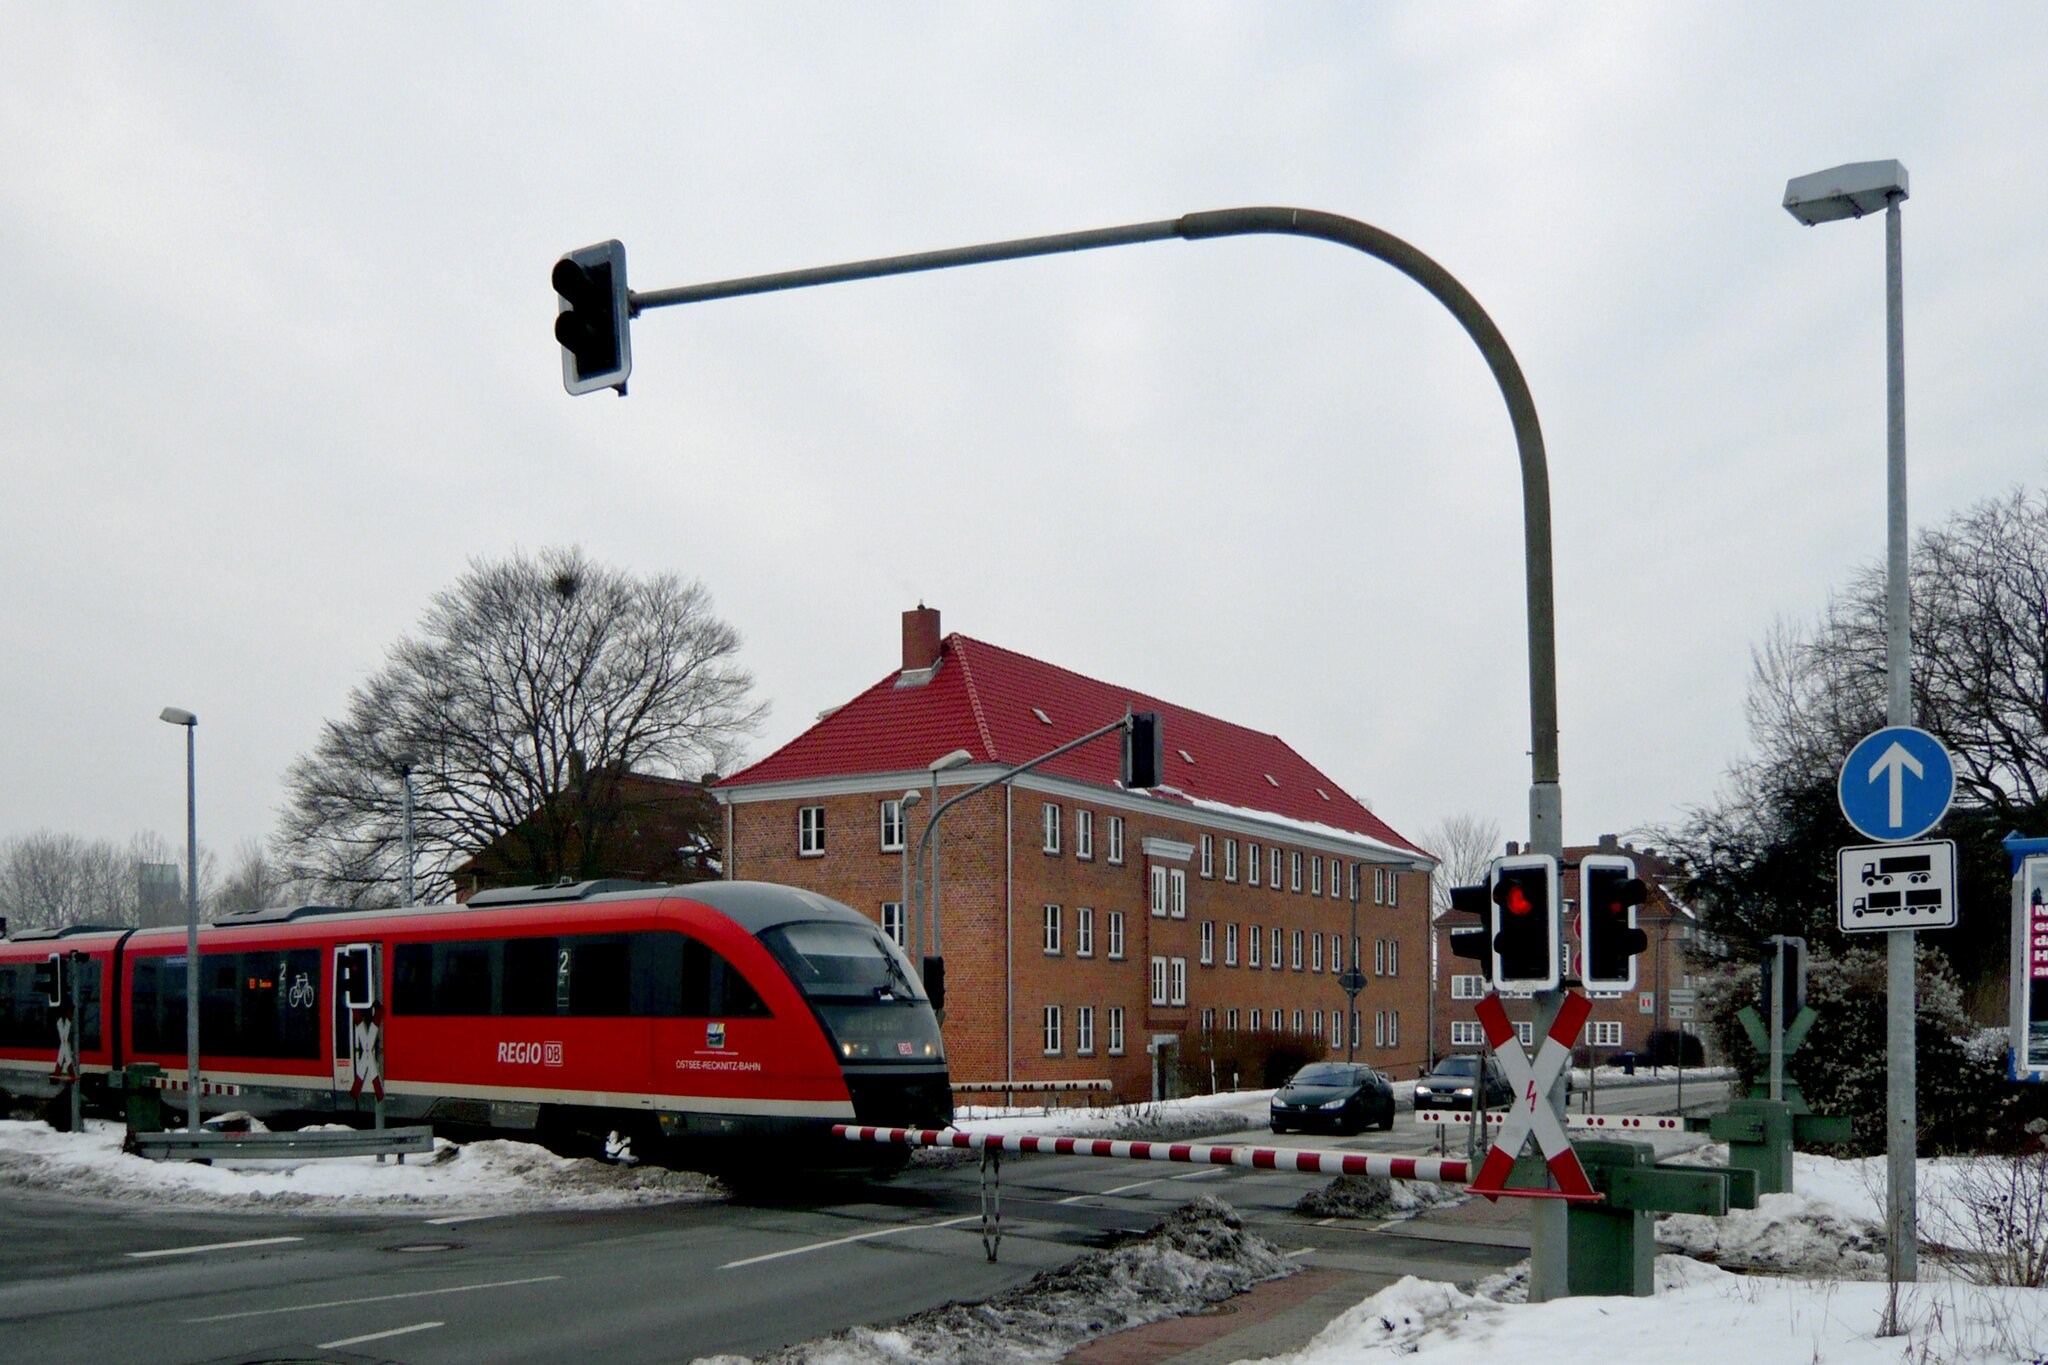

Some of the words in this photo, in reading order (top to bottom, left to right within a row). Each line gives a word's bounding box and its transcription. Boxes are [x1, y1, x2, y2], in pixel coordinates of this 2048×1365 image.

[279, 962, 287, 980] 2
[559, 951, 569, 973] 2
[497, 1041, 542, 1065] REGIO
[545, 1044, 562, 1064] DB
[675, 1059, 761, 1072] OSTSEE-RECKNITZ-BAHN
